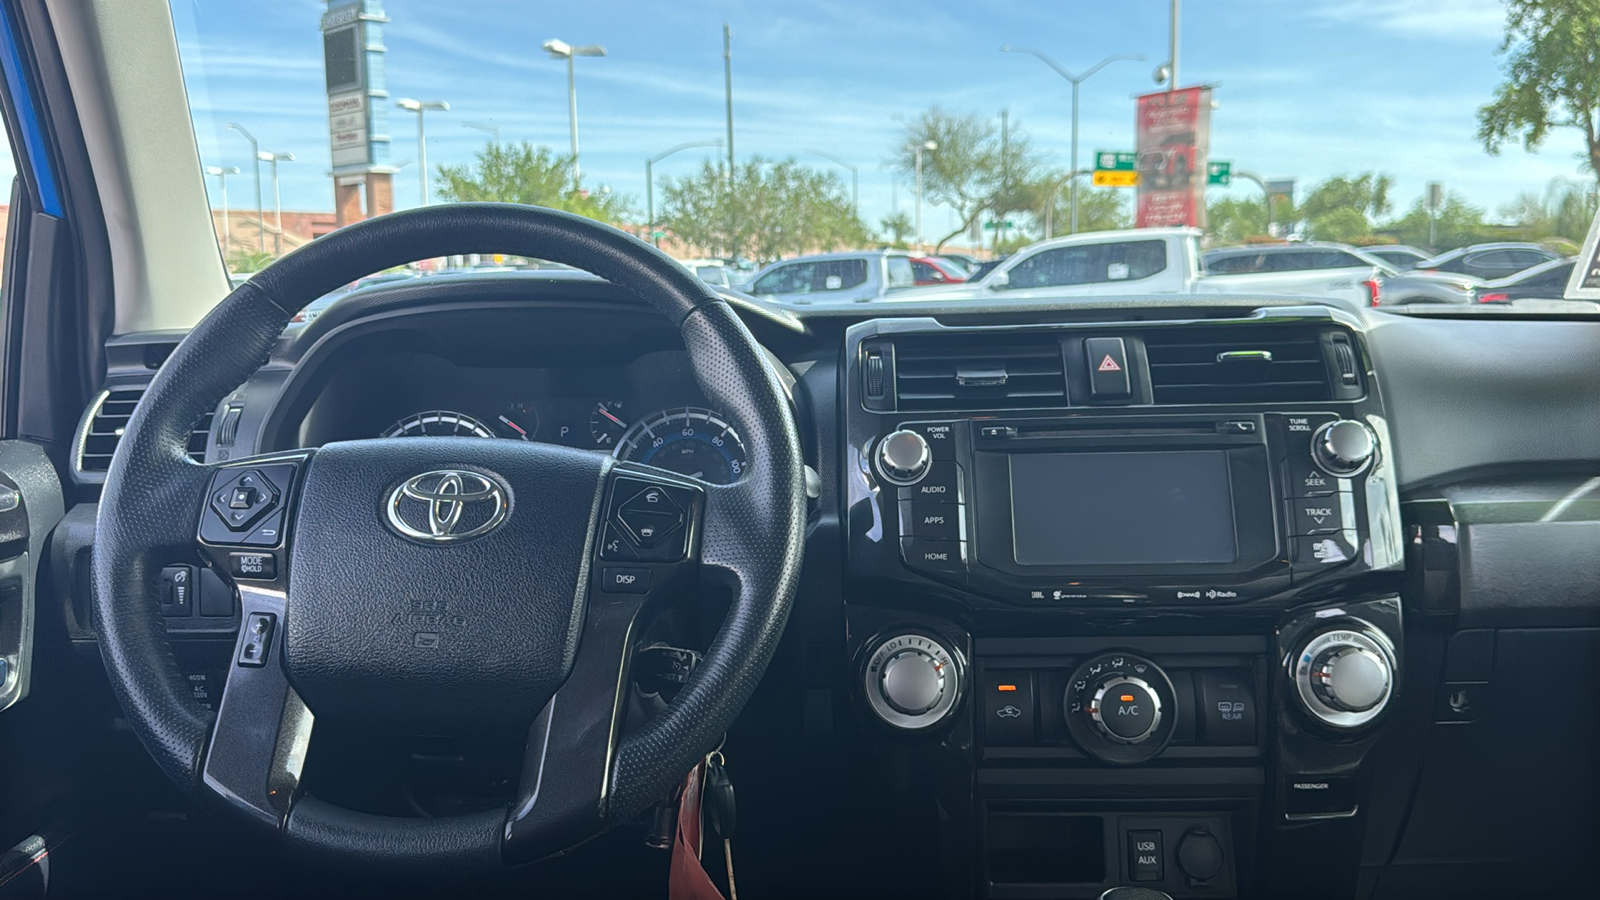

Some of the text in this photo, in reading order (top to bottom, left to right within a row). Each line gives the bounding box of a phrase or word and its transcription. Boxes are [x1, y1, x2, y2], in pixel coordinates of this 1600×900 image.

[560, 426, 569, 438] P
[681, 428, 694, 437] 60
[652, 437, 665, 449] 40
[711, 436, 724, 448] 80
[730, 458, 741, 474] 100
[1304, 478, 1326, 486] SEEK
[921, 485, 946, 494] AUDIO
[1305, 508, 1332, 516] TRACK
[924, 516, 944, 524] APPS
[241, 556, 263, 565] MODE
[924, 553, 948, 561] HOME
[247, 565, 262, 573] HOLD
[616, 574, 636, 584] DISP
[1031, 591, 1044, 599] JBL
[1217, 590, 1237, 598] Radio
[1332, 633, 1352, 641] TEMP
[886, 641, 897, 652] LO
[874, 651, 888, 666] OFF
[1118, 704, 1139, 716] A/C
[1221, 712, 1242, 720] REAR
[1137, 841, 1155, 851] USB
[1138, 855, 1157, 865] AUX
